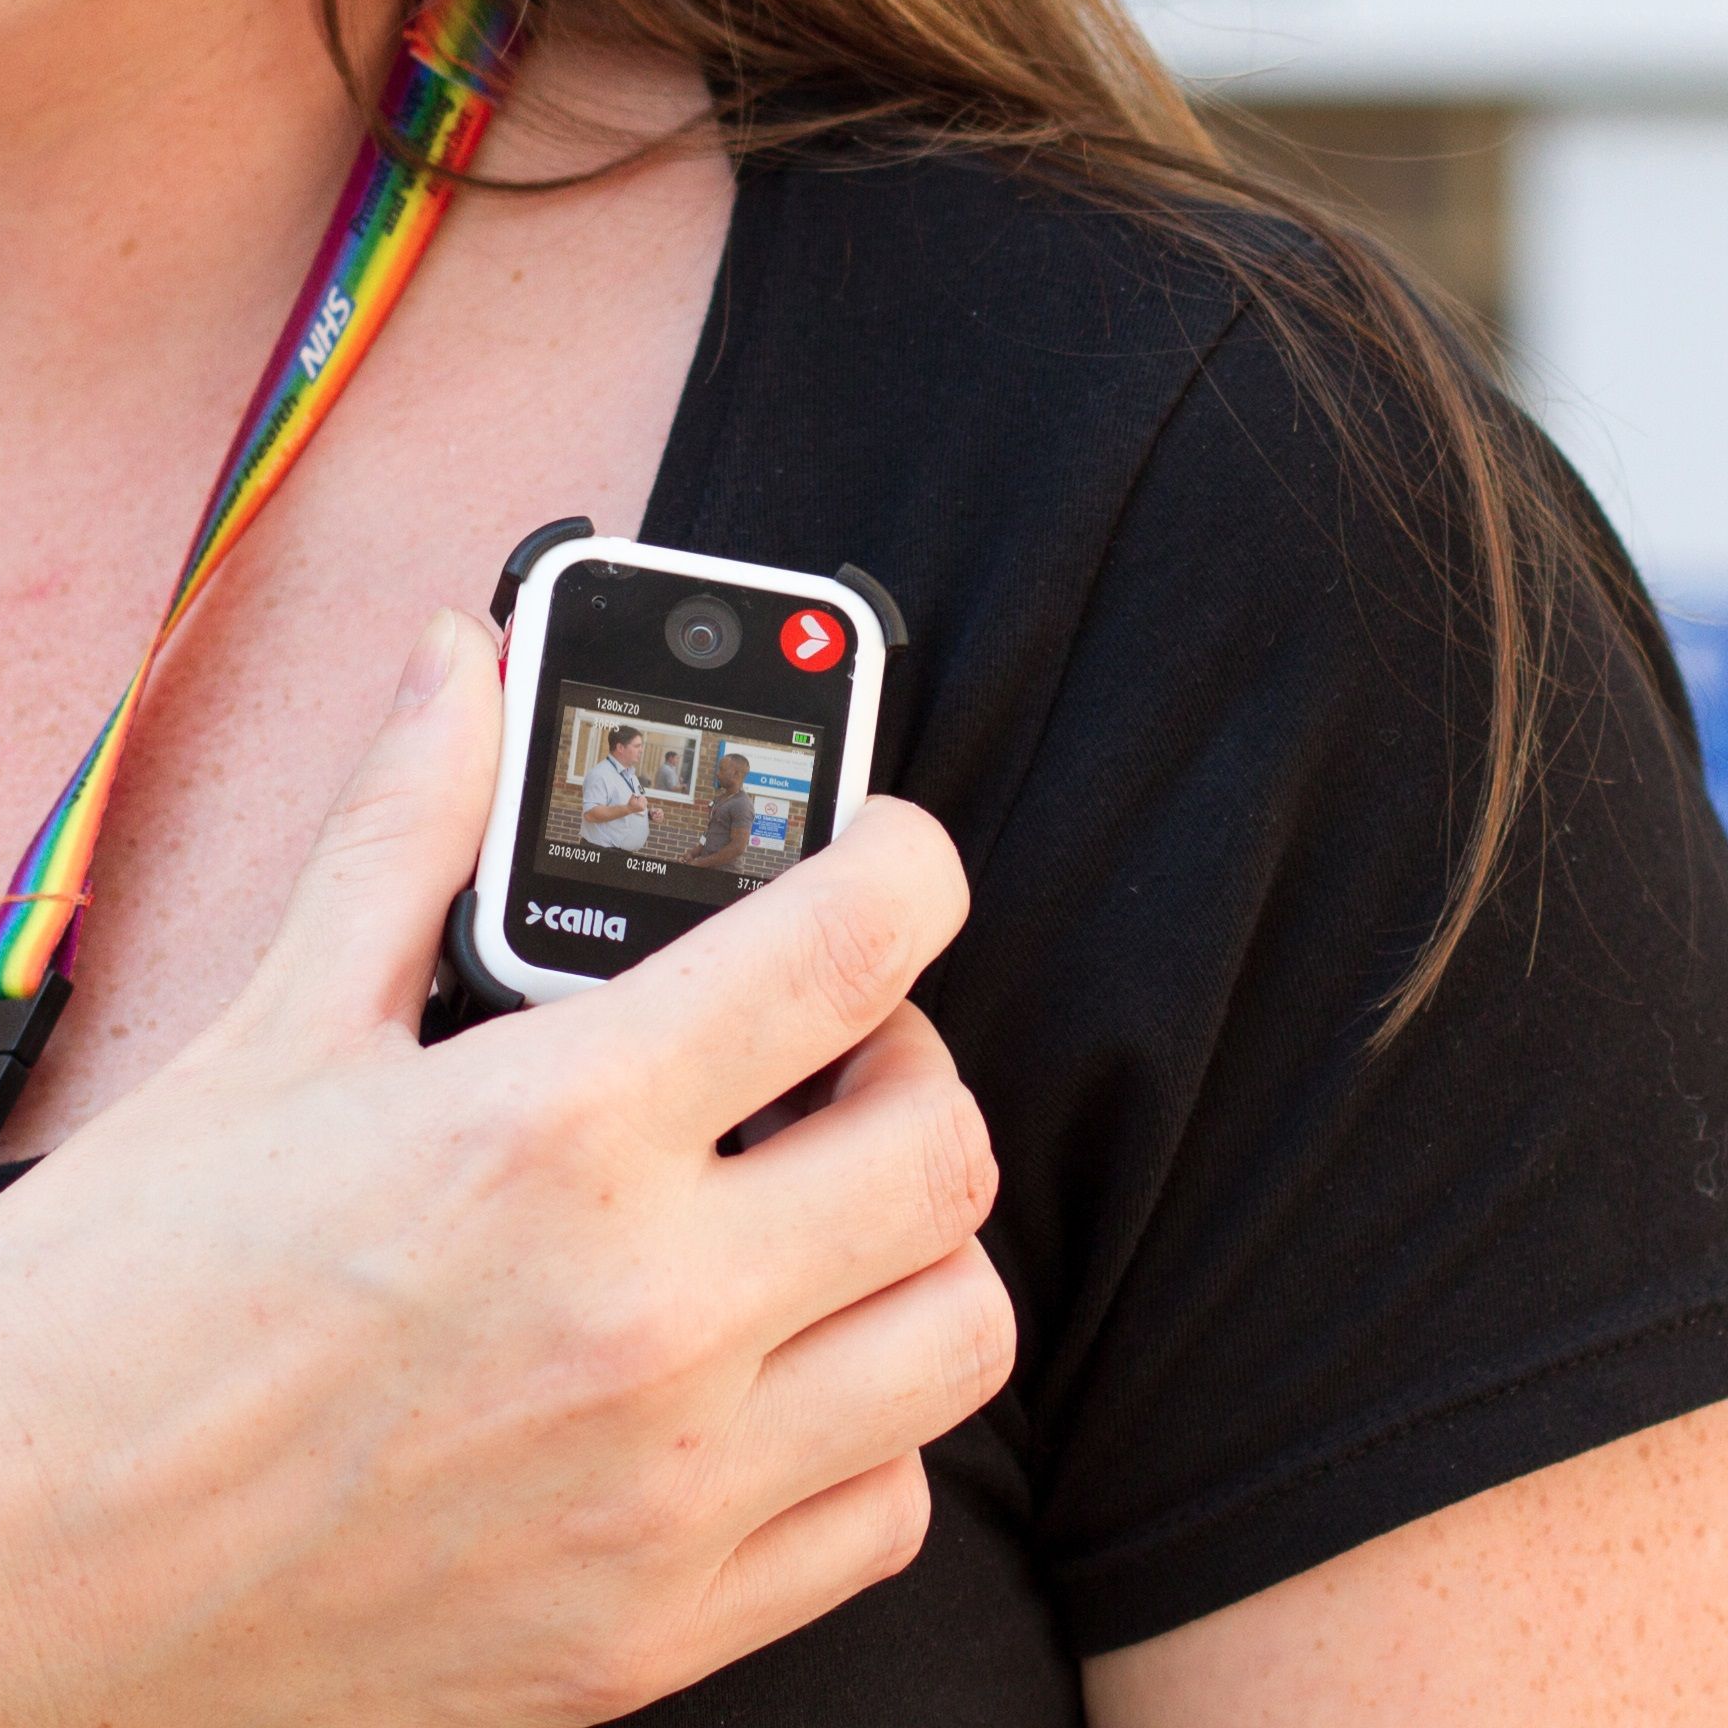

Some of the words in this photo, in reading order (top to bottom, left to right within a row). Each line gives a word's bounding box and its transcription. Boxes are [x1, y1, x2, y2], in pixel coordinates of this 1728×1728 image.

[298, 285, 352, 381] NHS
[596, 697, 640, 715] 1280x720
[684, 713, 723, 730] 00:15:00
[548, 844, 601, 864] 2018/03/01
[626, 857, 667, 875] 02:18PM
